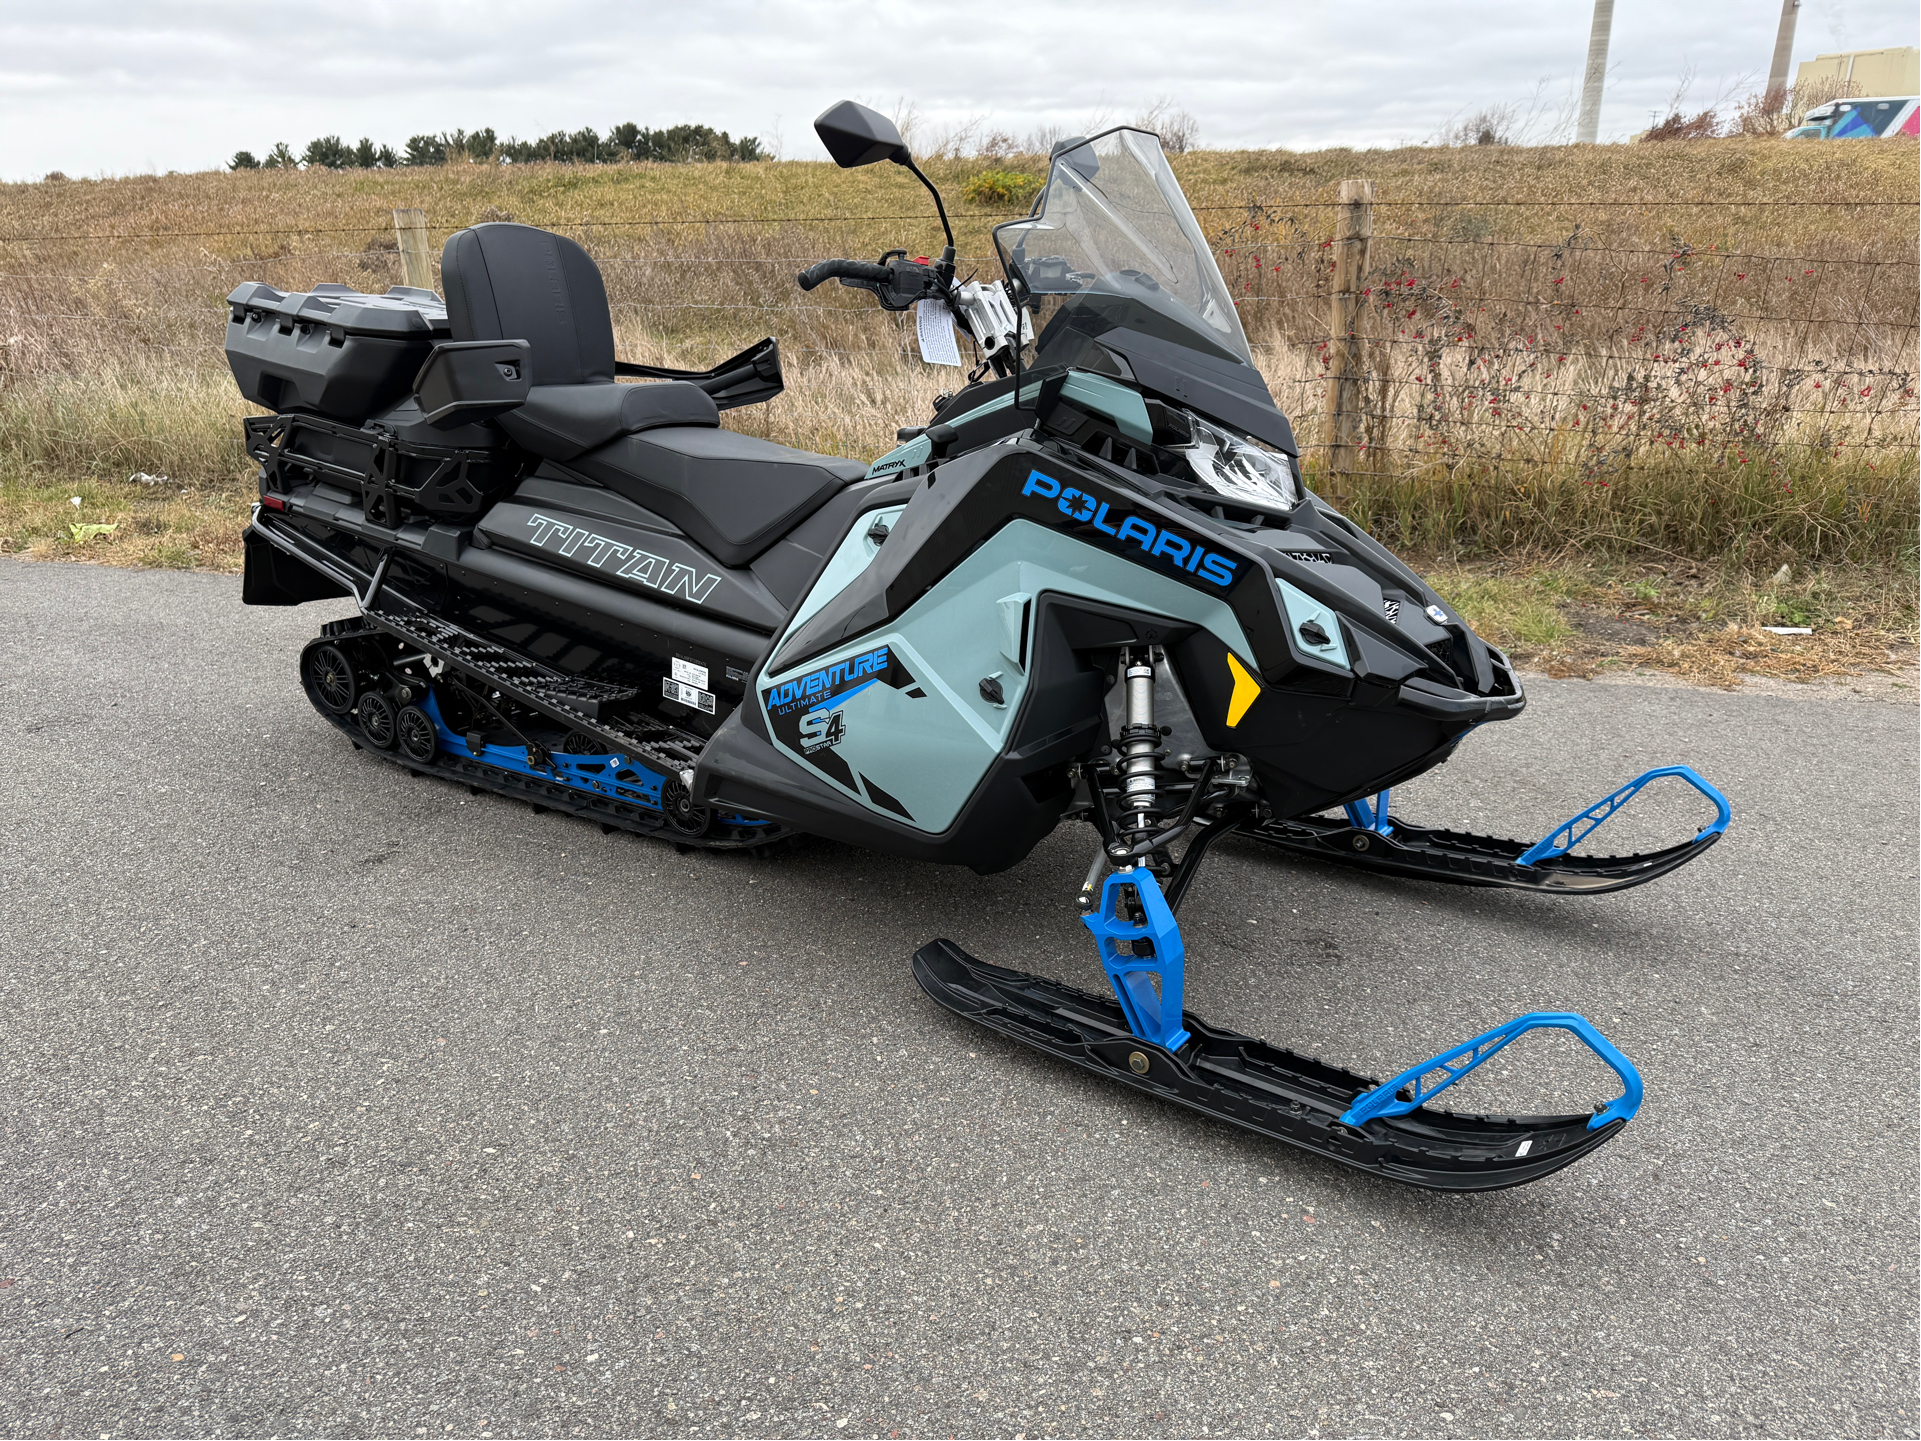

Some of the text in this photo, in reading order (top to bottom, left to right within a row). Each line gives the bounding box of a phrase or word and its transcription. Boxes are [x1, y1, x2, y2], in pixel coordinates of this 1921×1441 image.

[871, 458, 907, 476] MATRYX
[1021, 469, 1239, 587] POLARIS
[527, 513, 722, 604] TITAN
[767, 646, 889, 710] ADVENTURE
[778, 690, 832, 716] ULTIMATE
[1360, 1083, 1399, 1115] POLARIS
